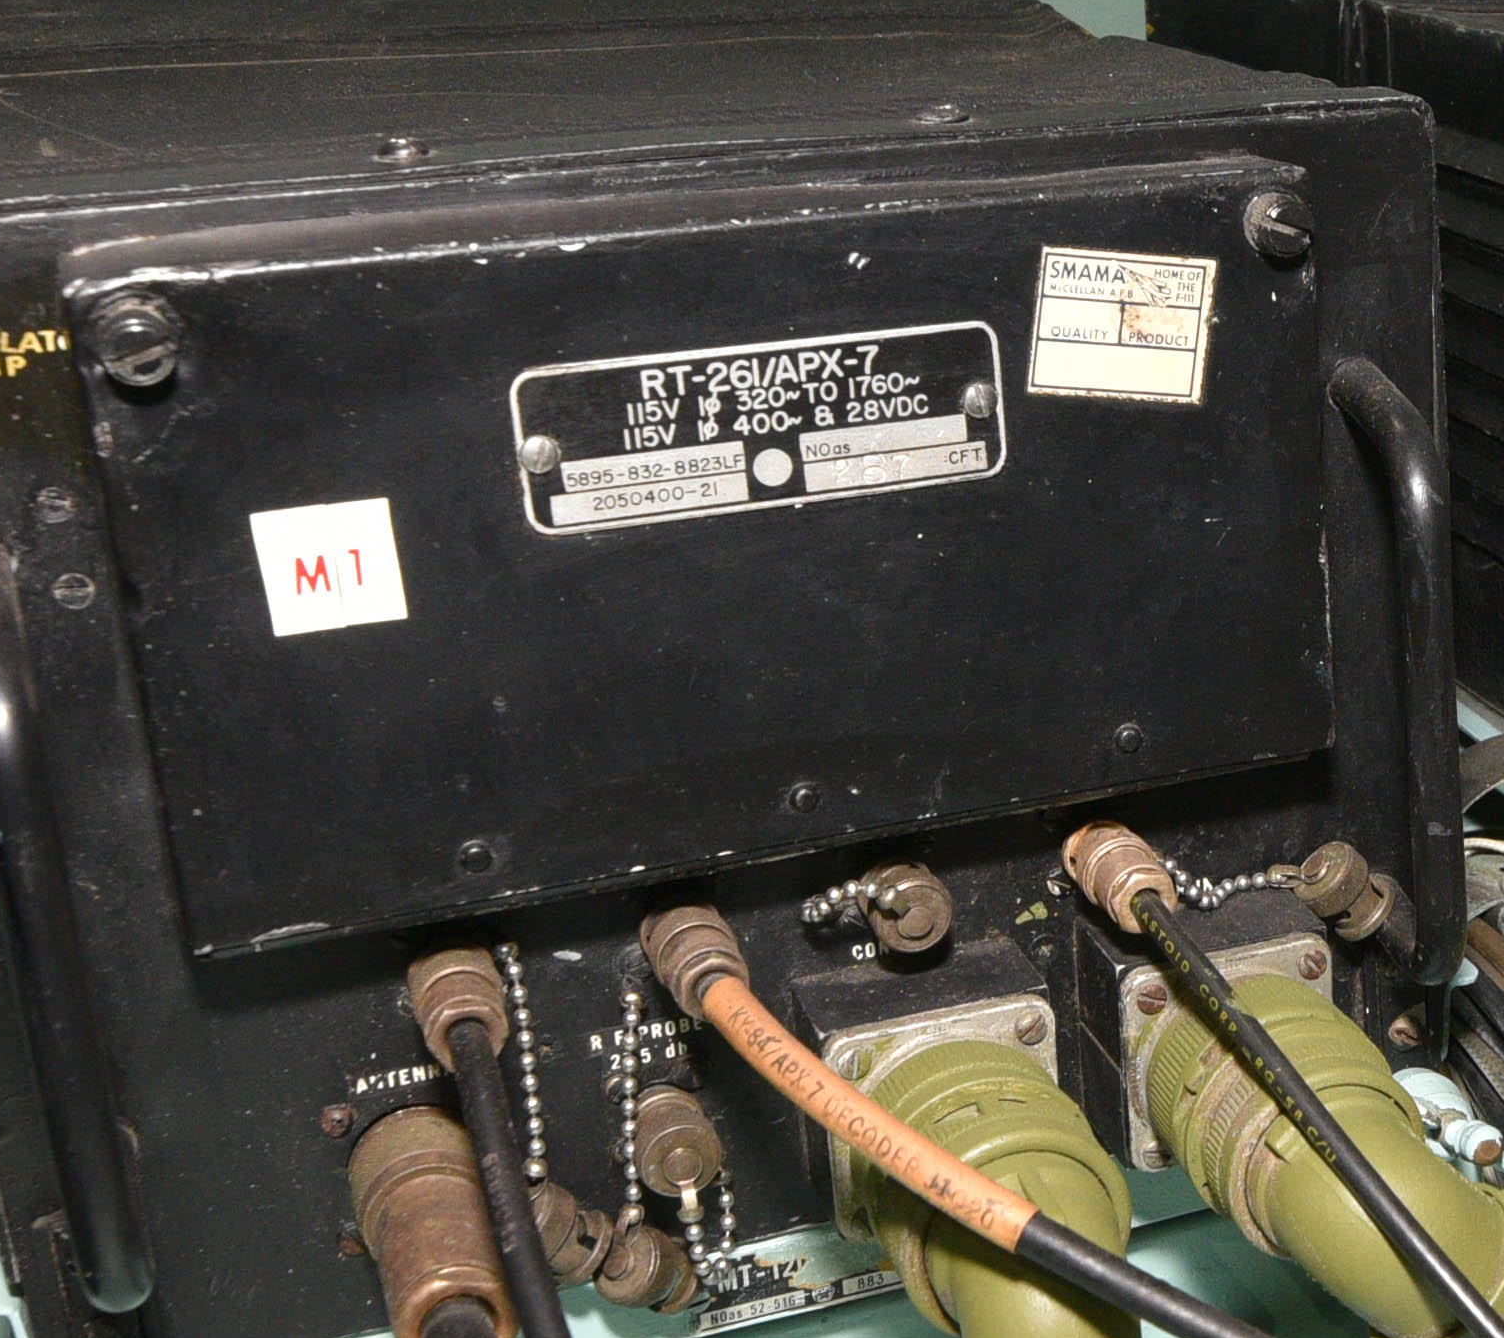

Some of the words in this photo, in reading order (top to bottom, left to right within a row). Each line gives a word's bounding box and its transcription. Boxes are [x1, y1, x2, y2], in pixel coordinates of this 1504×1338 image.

[1049, 261, 1126, 284] SMAMA
[1154, 269, 1185, 281] HOME
[1187, 271, 1202, 281] OF
[1177, 282, 1195, 292] THE
[1051, 325, 1108, 340] QUALITY
[1128, 332, 1189, 347] PRODUCT
[639, 345, 879, 400] RT-261/APX-7
[626, 399, 680, 426] 115V
[805, 382, 838, 404] TO
[623, 425, 676, 451] 115V
[815, 406, 834, 426] &
[847, 394, 928, 422] 28VDC
[566, 455, 744, 487] 5895-832-8823LF
[592, 483, 718, 511] 2050400-21
[639, 1018, 703, 1045] PROBE
[355, 1063, 443, 1095] ANTENN
[857, 1273, 885, 1290] 883
